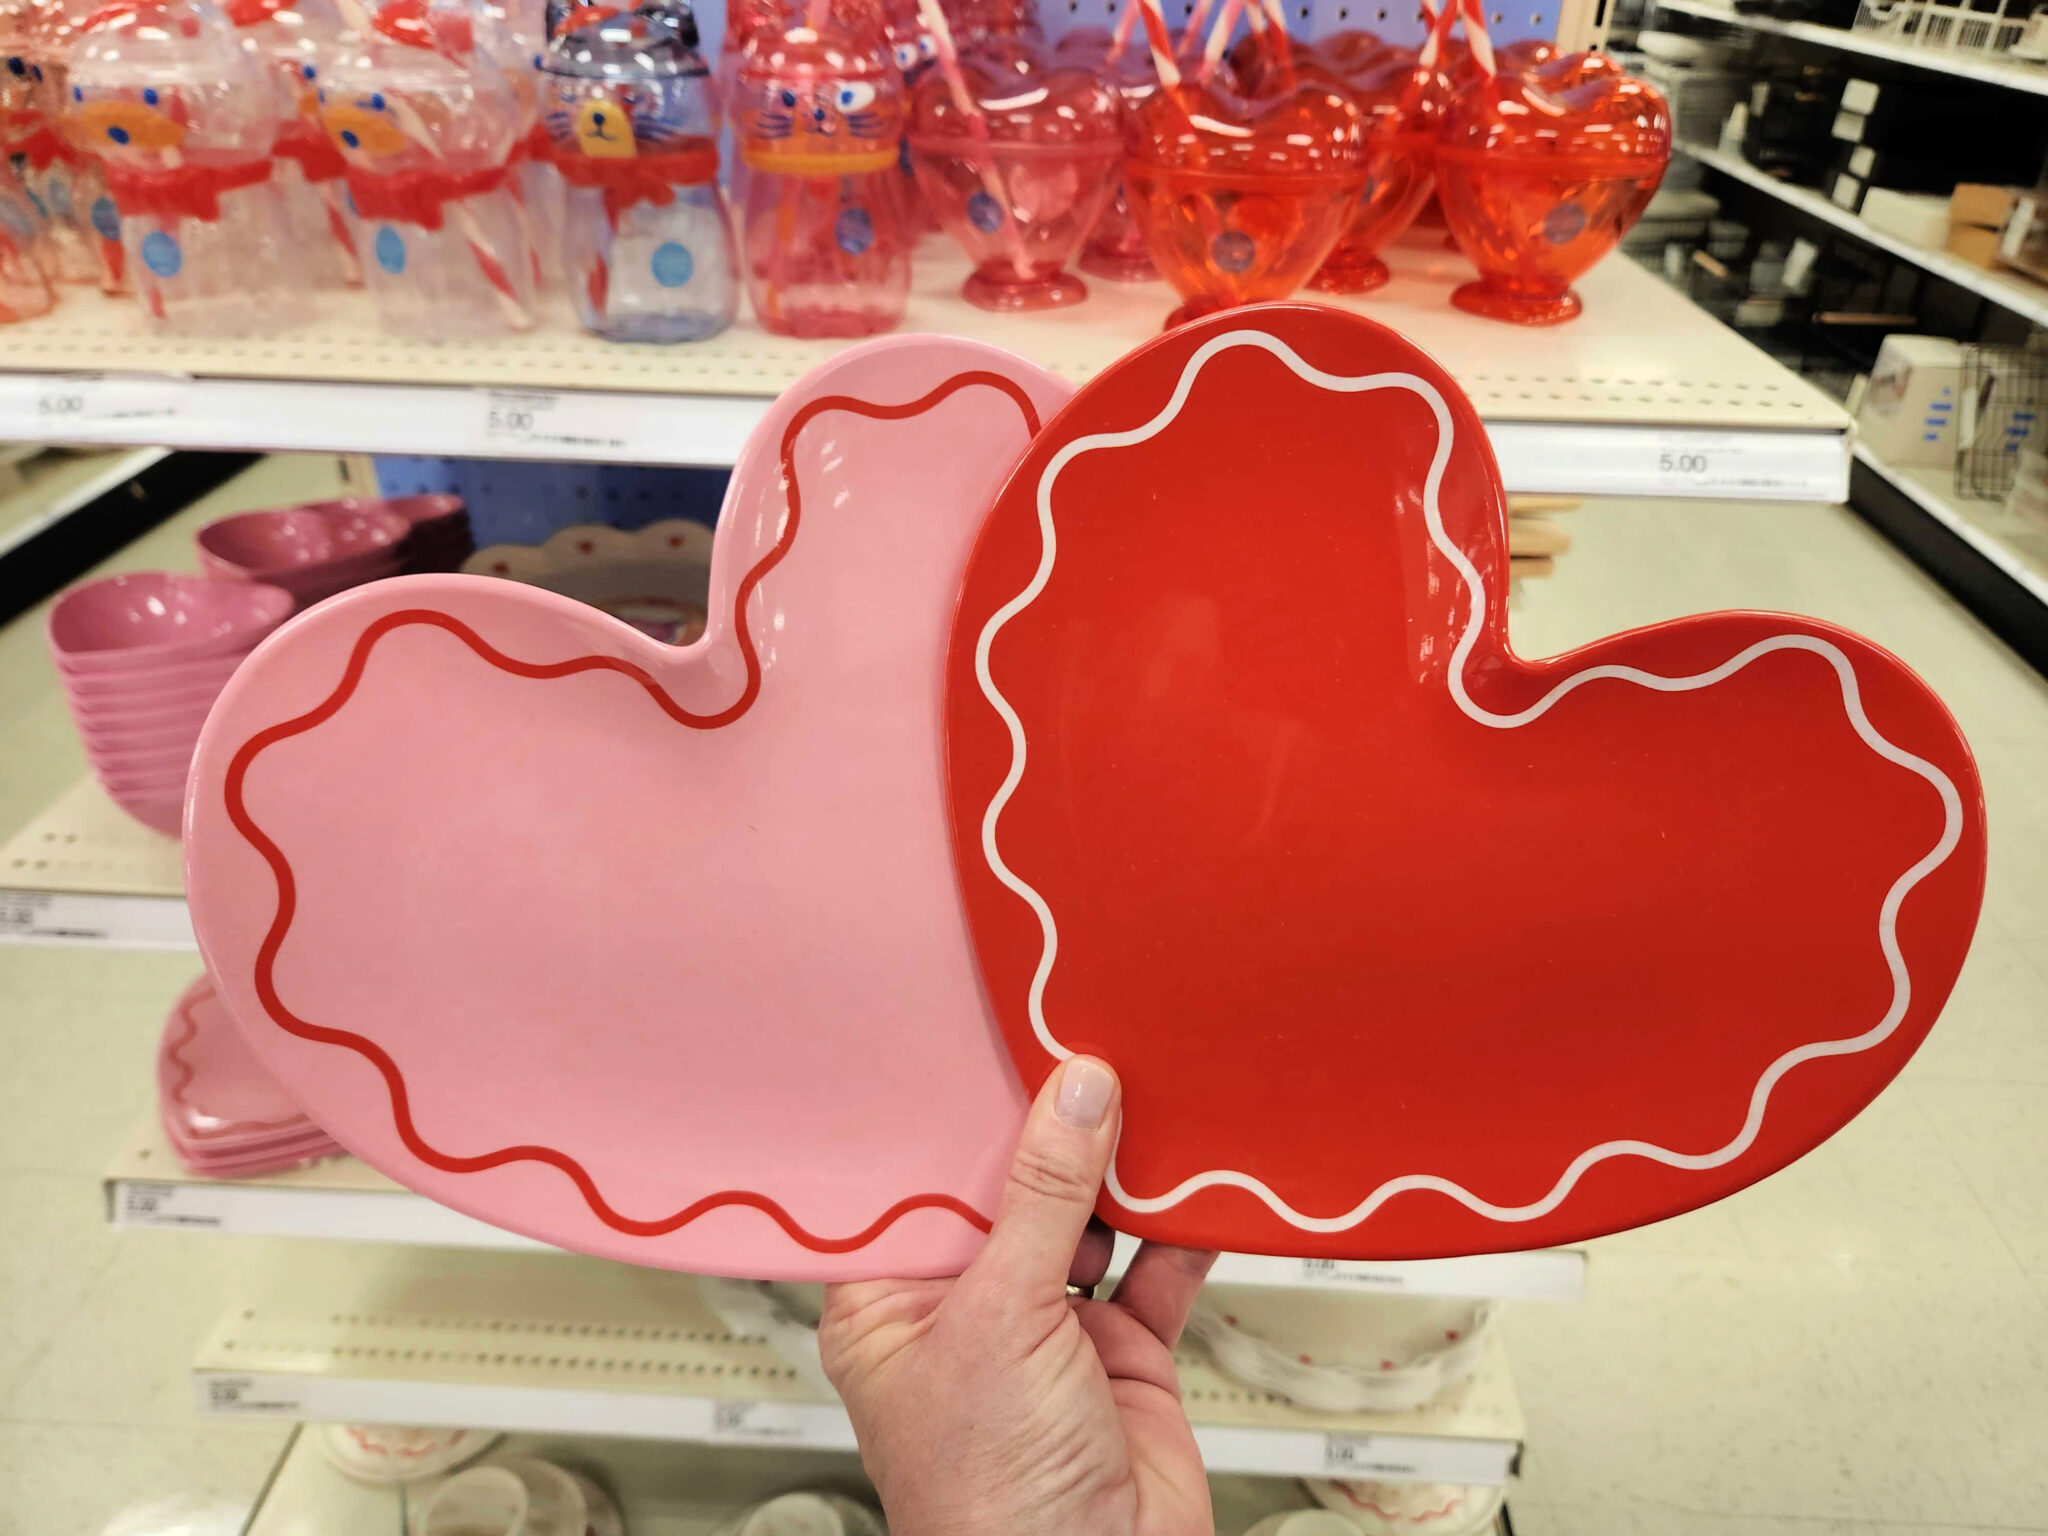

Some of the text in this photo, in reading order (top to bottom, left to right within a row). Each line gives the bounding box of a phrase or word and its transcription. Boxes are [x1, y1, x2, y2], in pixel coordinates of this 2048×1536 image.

[38, 396, 83, 415] 5.00
[489, 411, 533, 431] 5.00
[1660, 454, 1707, 473] 5.00
